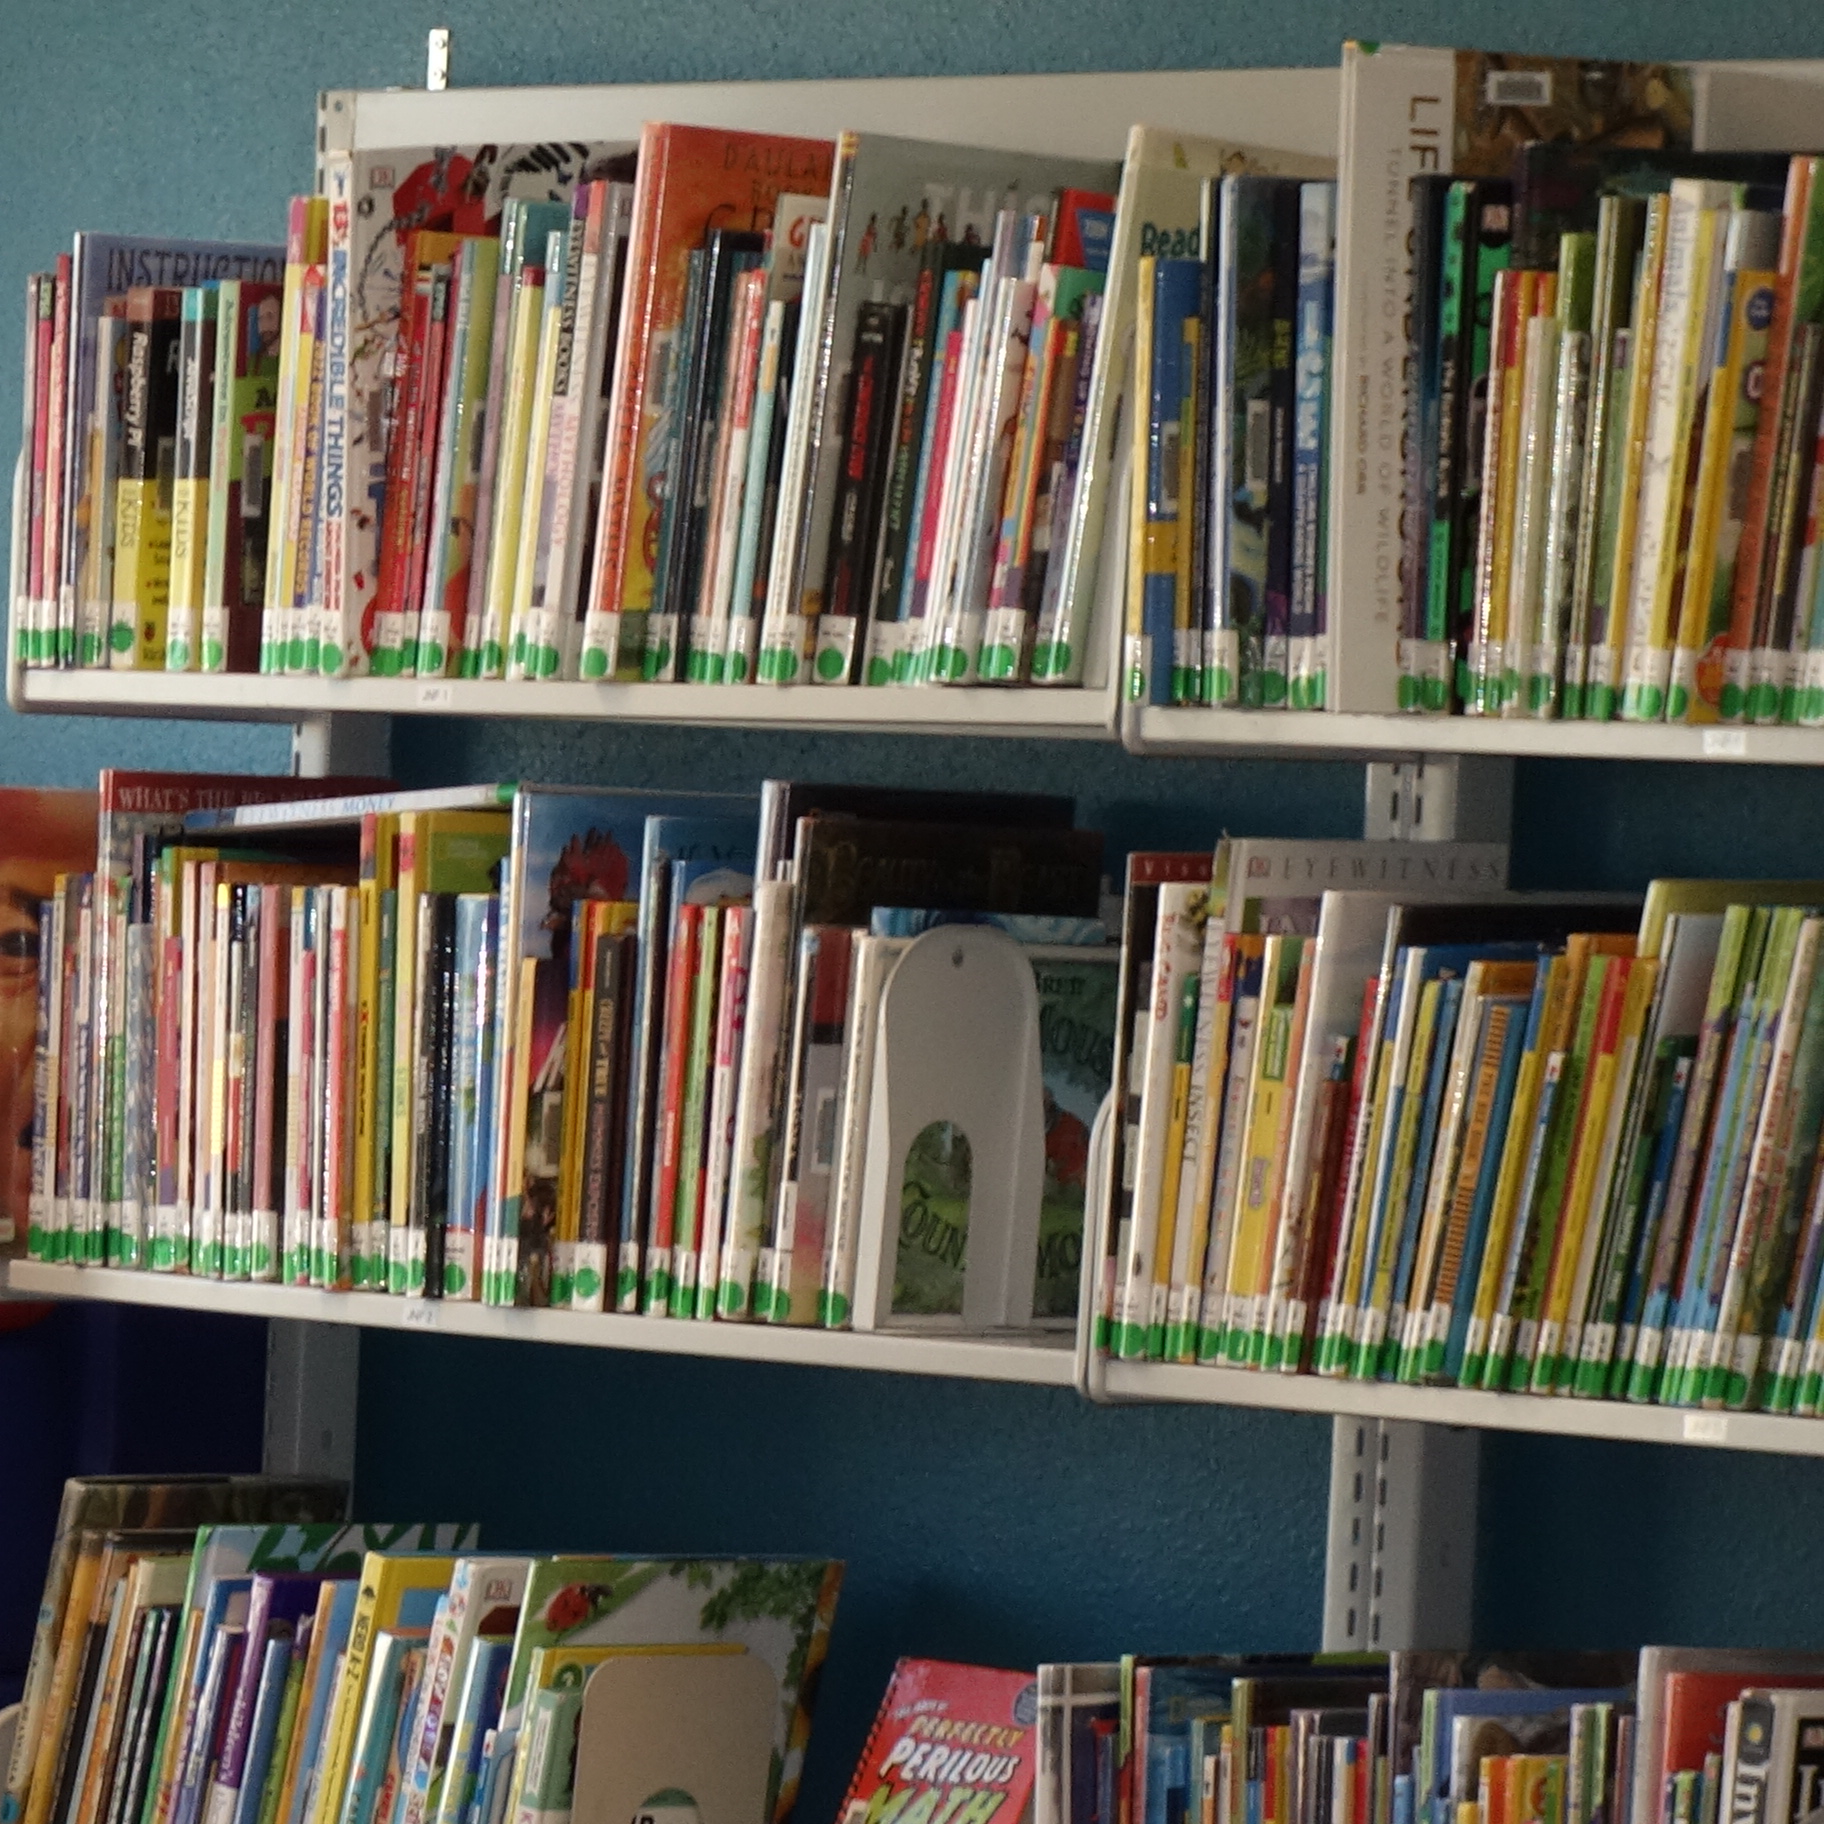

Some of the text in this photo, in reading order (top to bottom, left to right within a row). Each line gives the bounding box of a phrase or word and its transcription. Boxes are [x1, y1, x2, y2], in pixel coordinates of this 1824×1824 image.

[1410, 94, 1440, 178] LIF
[1381, 147, 1402, 246] TUNNEL
[328, 249, 349, 410] INCREDIBLE
[1381, 263, 1399, 324] INTO
[124, 331, 149, 424] Raspberry
[1378, 357, 1394, 451] WORLD
[325, 416, 347, 517] THINGS
[1378, 463, 1392, 494] OF
[1372, 507, 1391, 624] WILDLIFE
[116, 785, 190, 811] WHAT'S
[1283, 855, 1502, 881] EYEWITNESS
[1183, 1084, 1206, 1165] INSECT
[878, 1734, 1023, 1785] PERILOUS
[909, 1714, 1026, 1748] PERFECTLY
